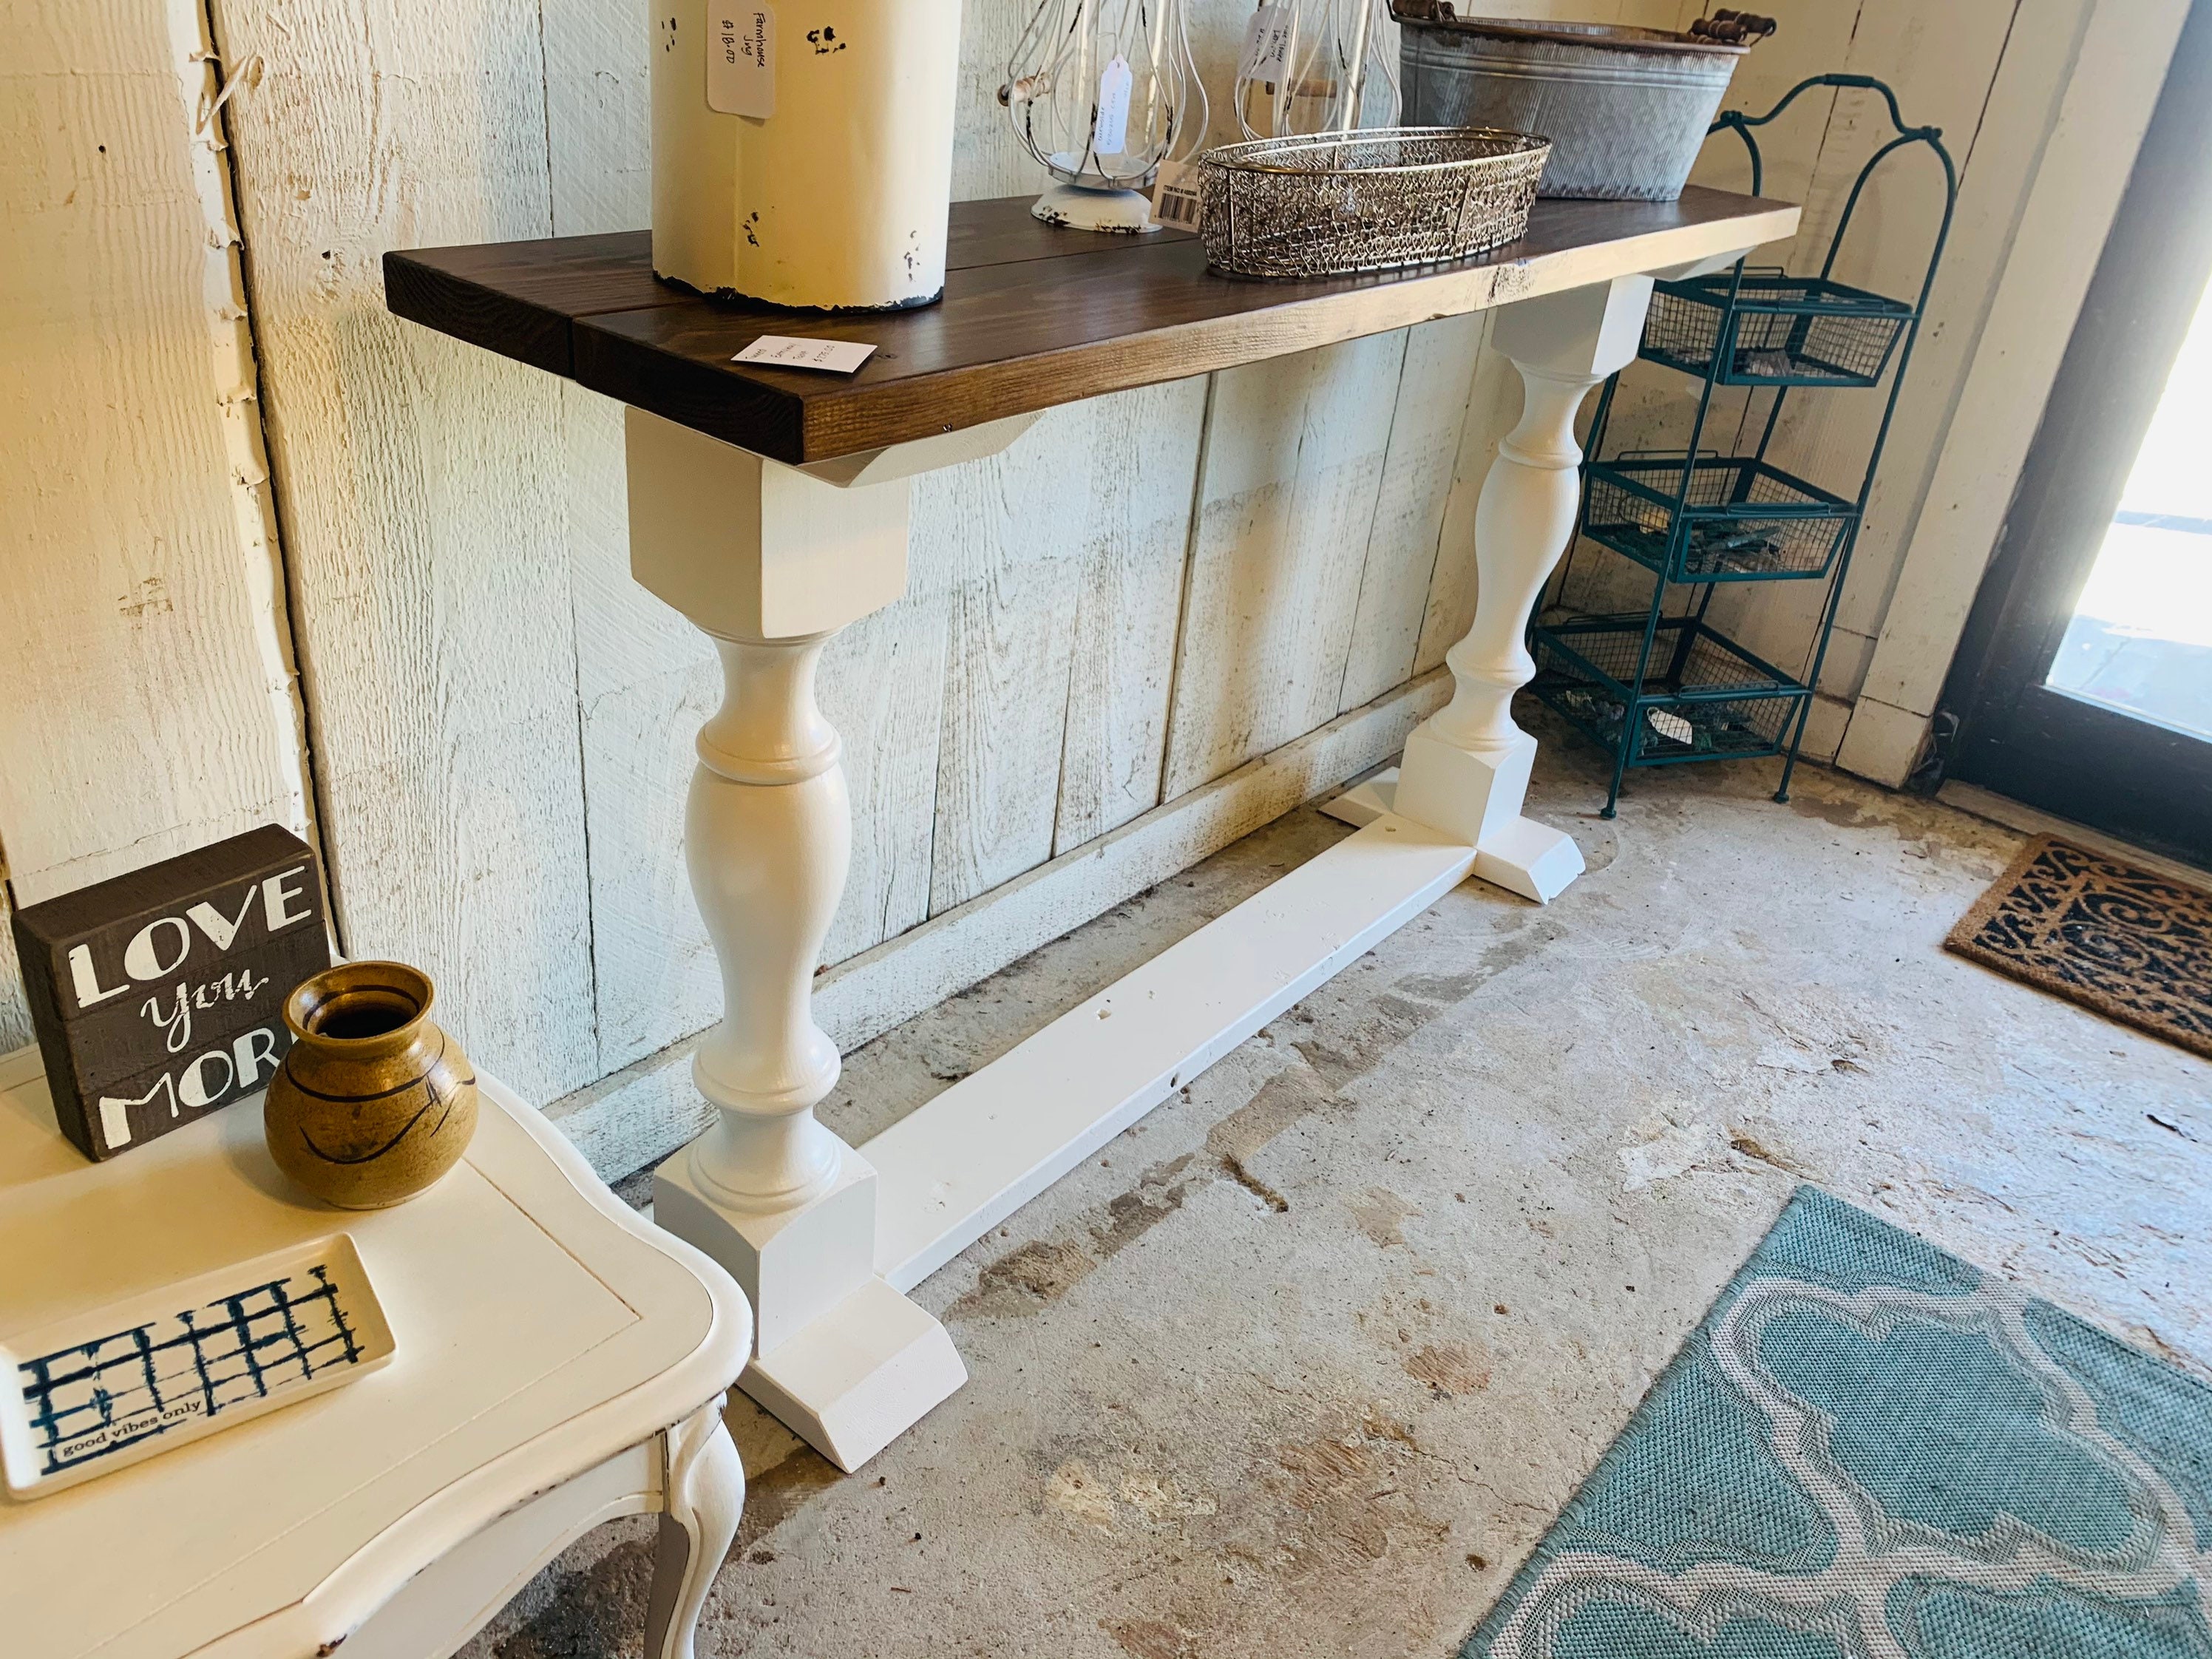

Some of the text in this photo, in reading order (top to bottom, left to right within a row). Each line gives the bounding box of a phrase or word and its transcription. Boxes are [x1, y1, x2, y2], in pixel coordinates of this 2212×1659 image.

[742, 35, 753, 56] Jug
[753, 12, 767, 67] Farmhouse
[68, 866, 312, 1008] LOVE
[140, 969, 269, 1053] you
[99, 1028, 298, 1149] MOR
[63, 1400, 201, 1456] good vibes only
